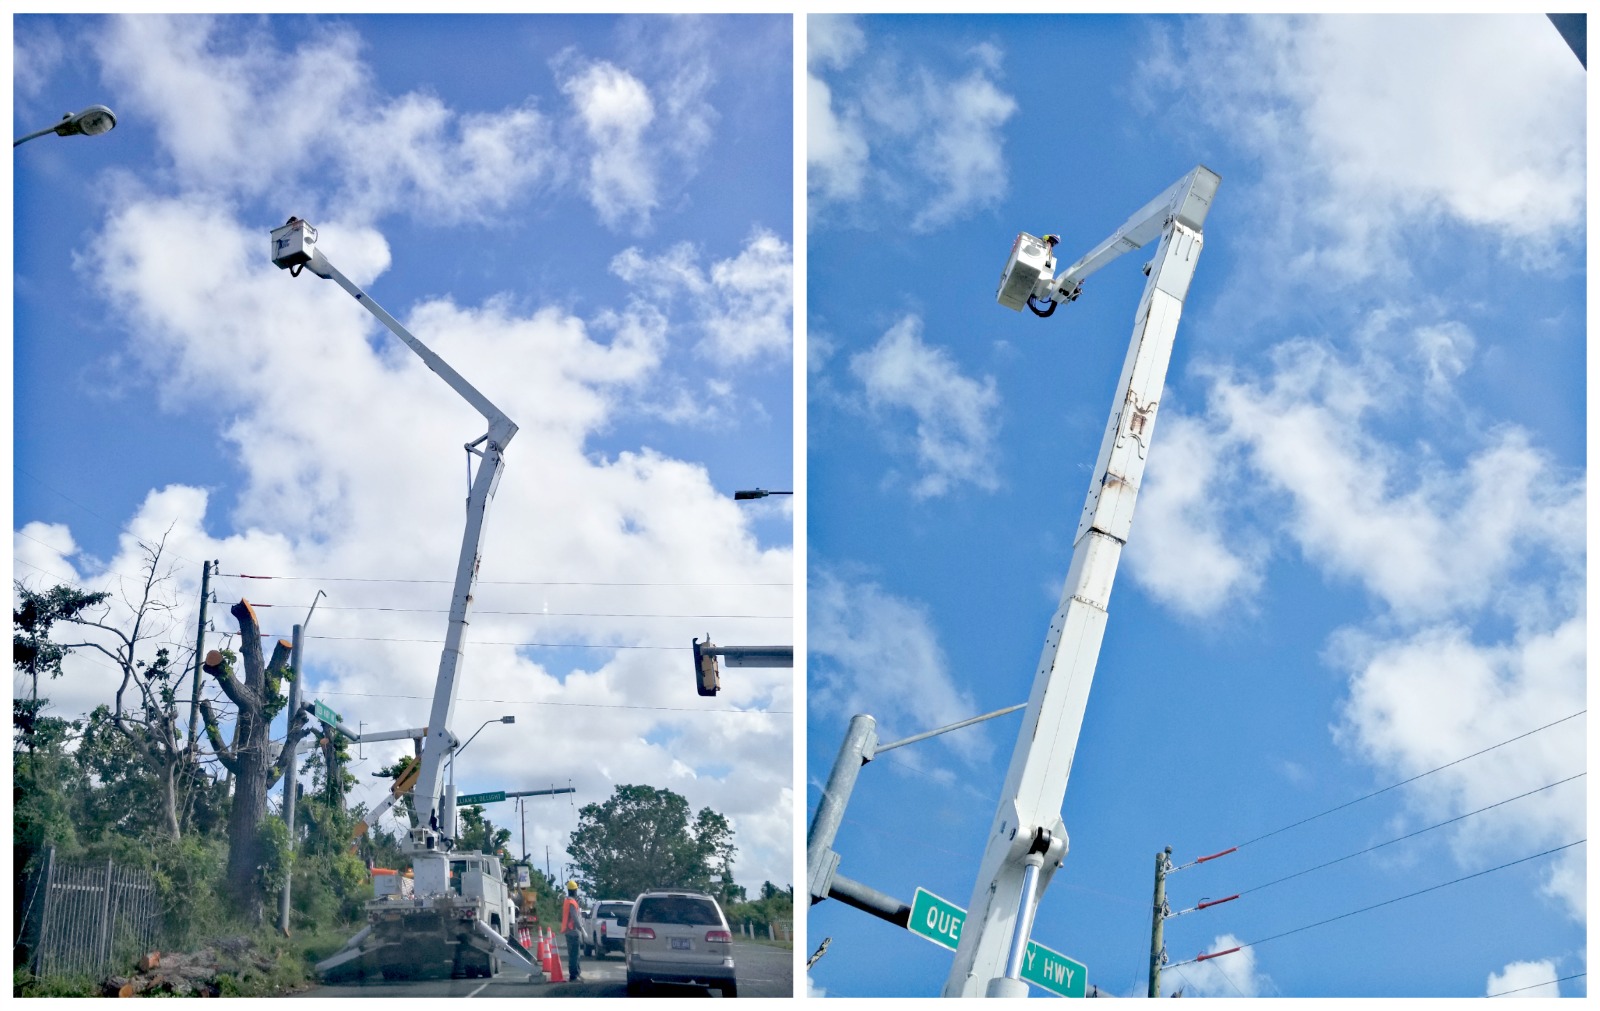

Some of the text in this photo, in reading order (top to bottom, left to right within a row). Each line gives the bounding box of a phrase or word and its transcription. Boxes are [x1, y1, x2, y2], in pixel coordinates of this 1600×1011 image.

[458, 796, 477, 804] LIAM'S
[926, 906, 964, 940] QUE
[1043, 957, 1075, 989] HWY
